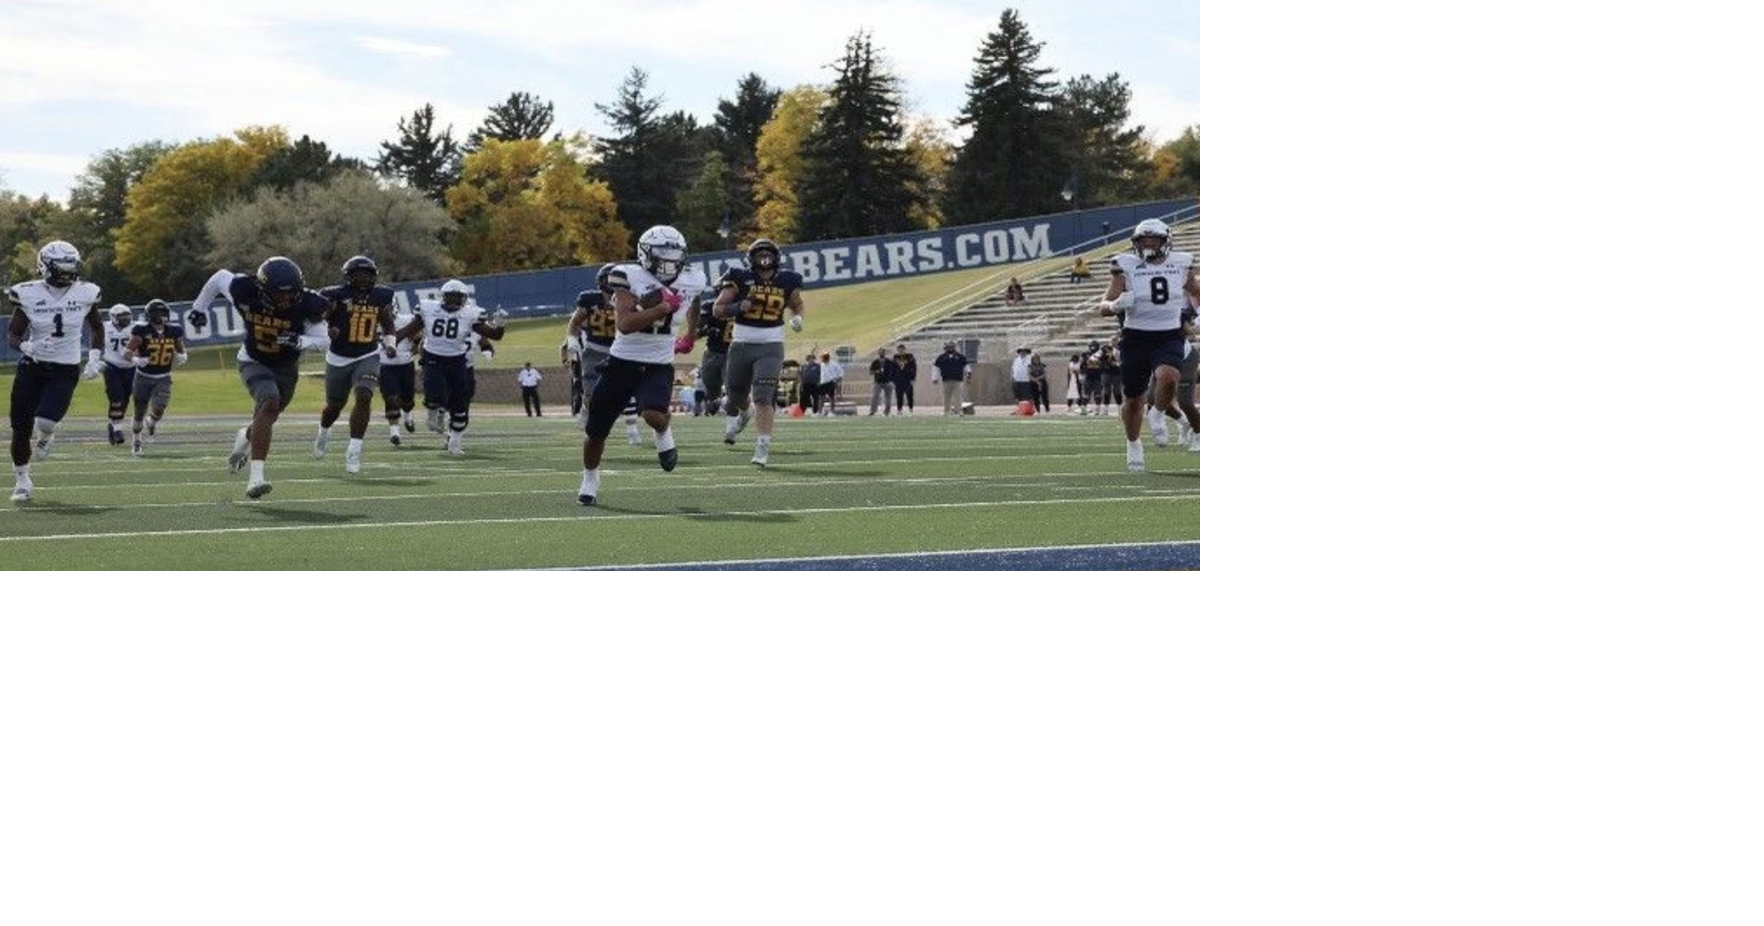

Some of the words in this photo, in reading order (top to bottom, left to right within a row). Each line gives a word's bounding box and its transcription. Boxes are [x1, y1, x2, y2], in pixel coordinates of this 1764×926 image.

[1150, 276, 1170, 305] 8
[51, 313, 65, 337] 1
[254, 325, 281, 353] 5
[348, 312, 379, 343] 10
[431, 318, 459, 339] 68
